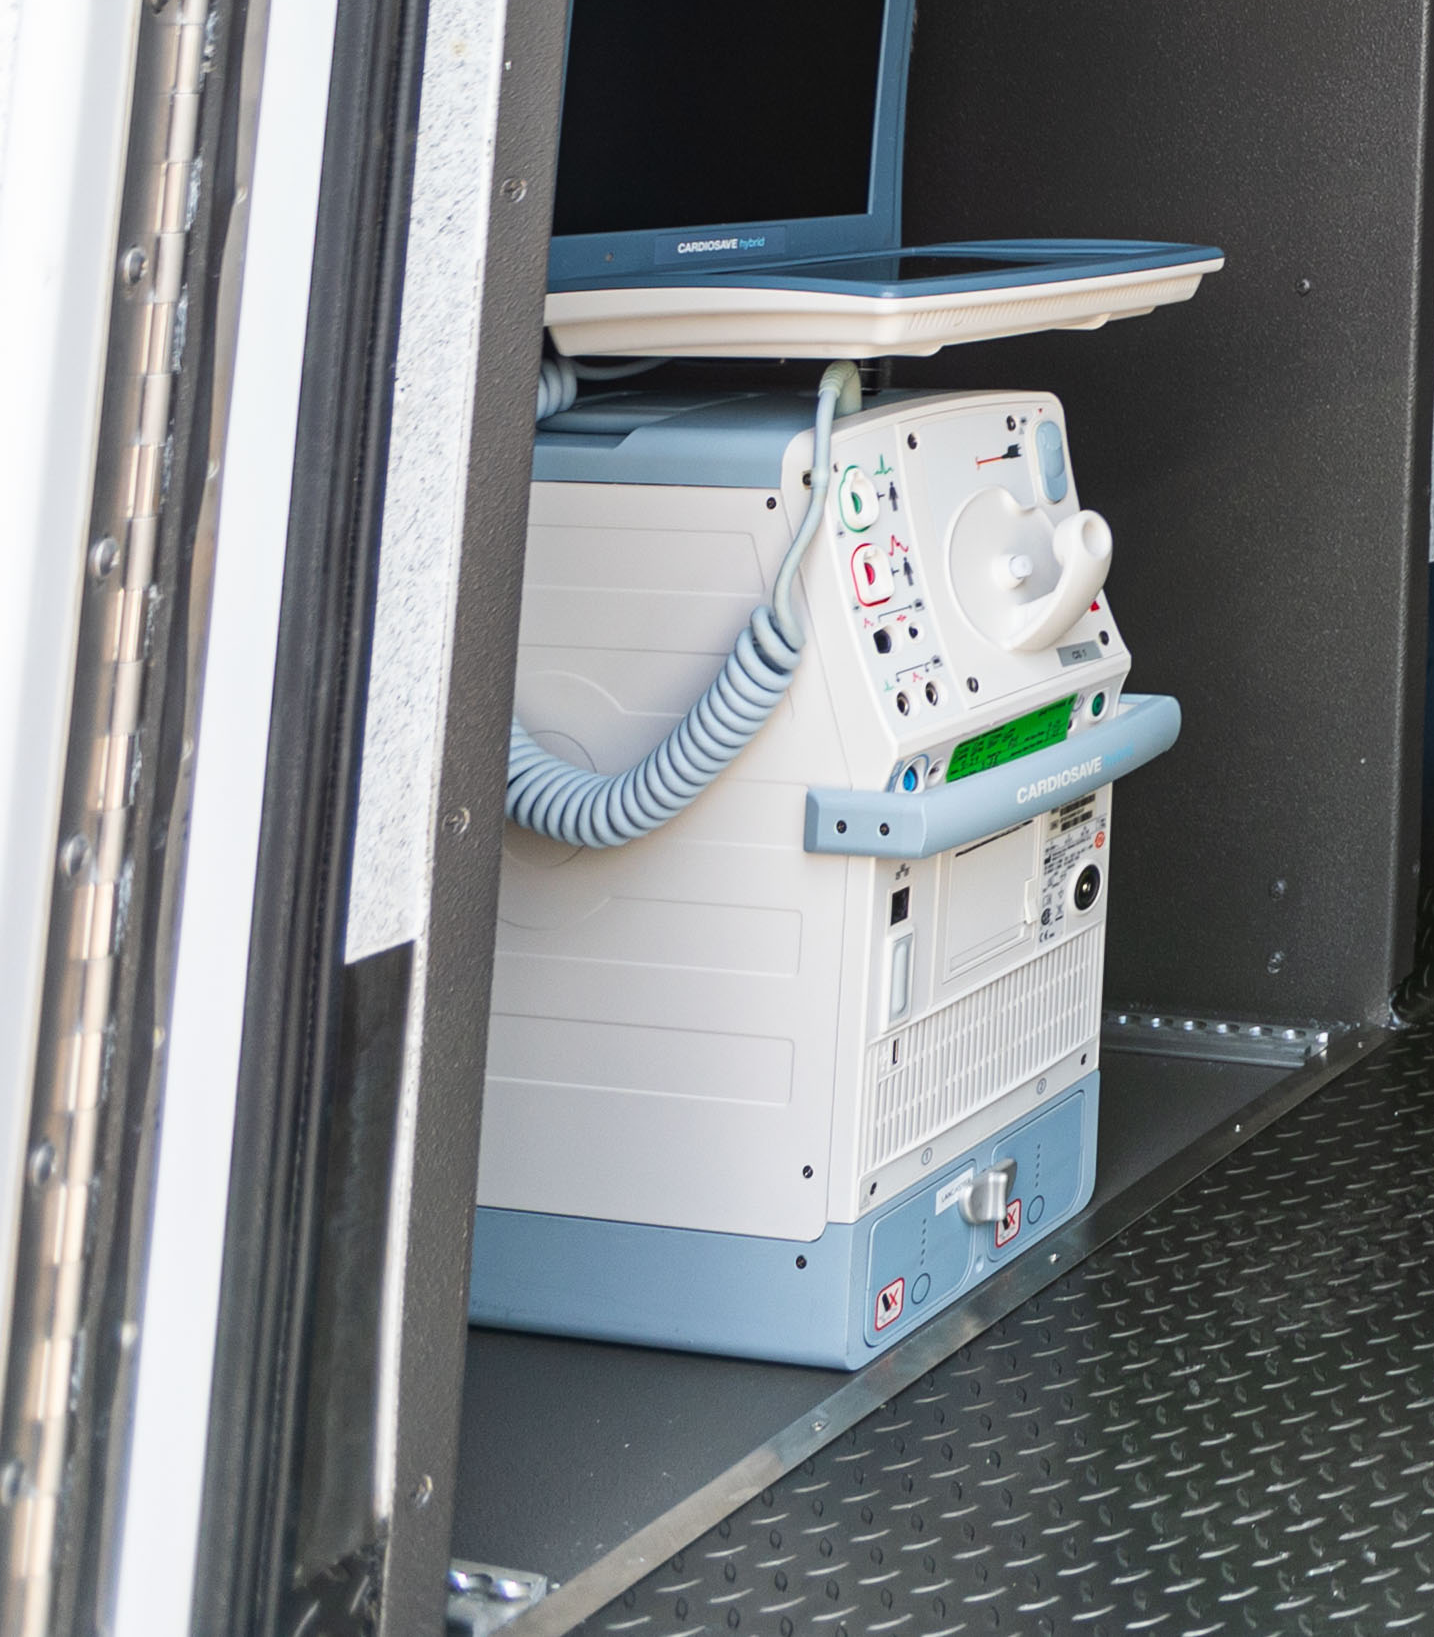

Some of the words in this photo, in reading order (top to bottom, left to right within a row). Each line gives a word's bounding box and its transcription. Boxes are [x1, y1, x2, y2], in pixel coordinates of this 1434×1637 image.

[677, 238, 738, 253] CARDIOSAVE
[739, 236, 765, 250] hybrid
[1016, 756, 1103, 804] CARDIOSAVE
